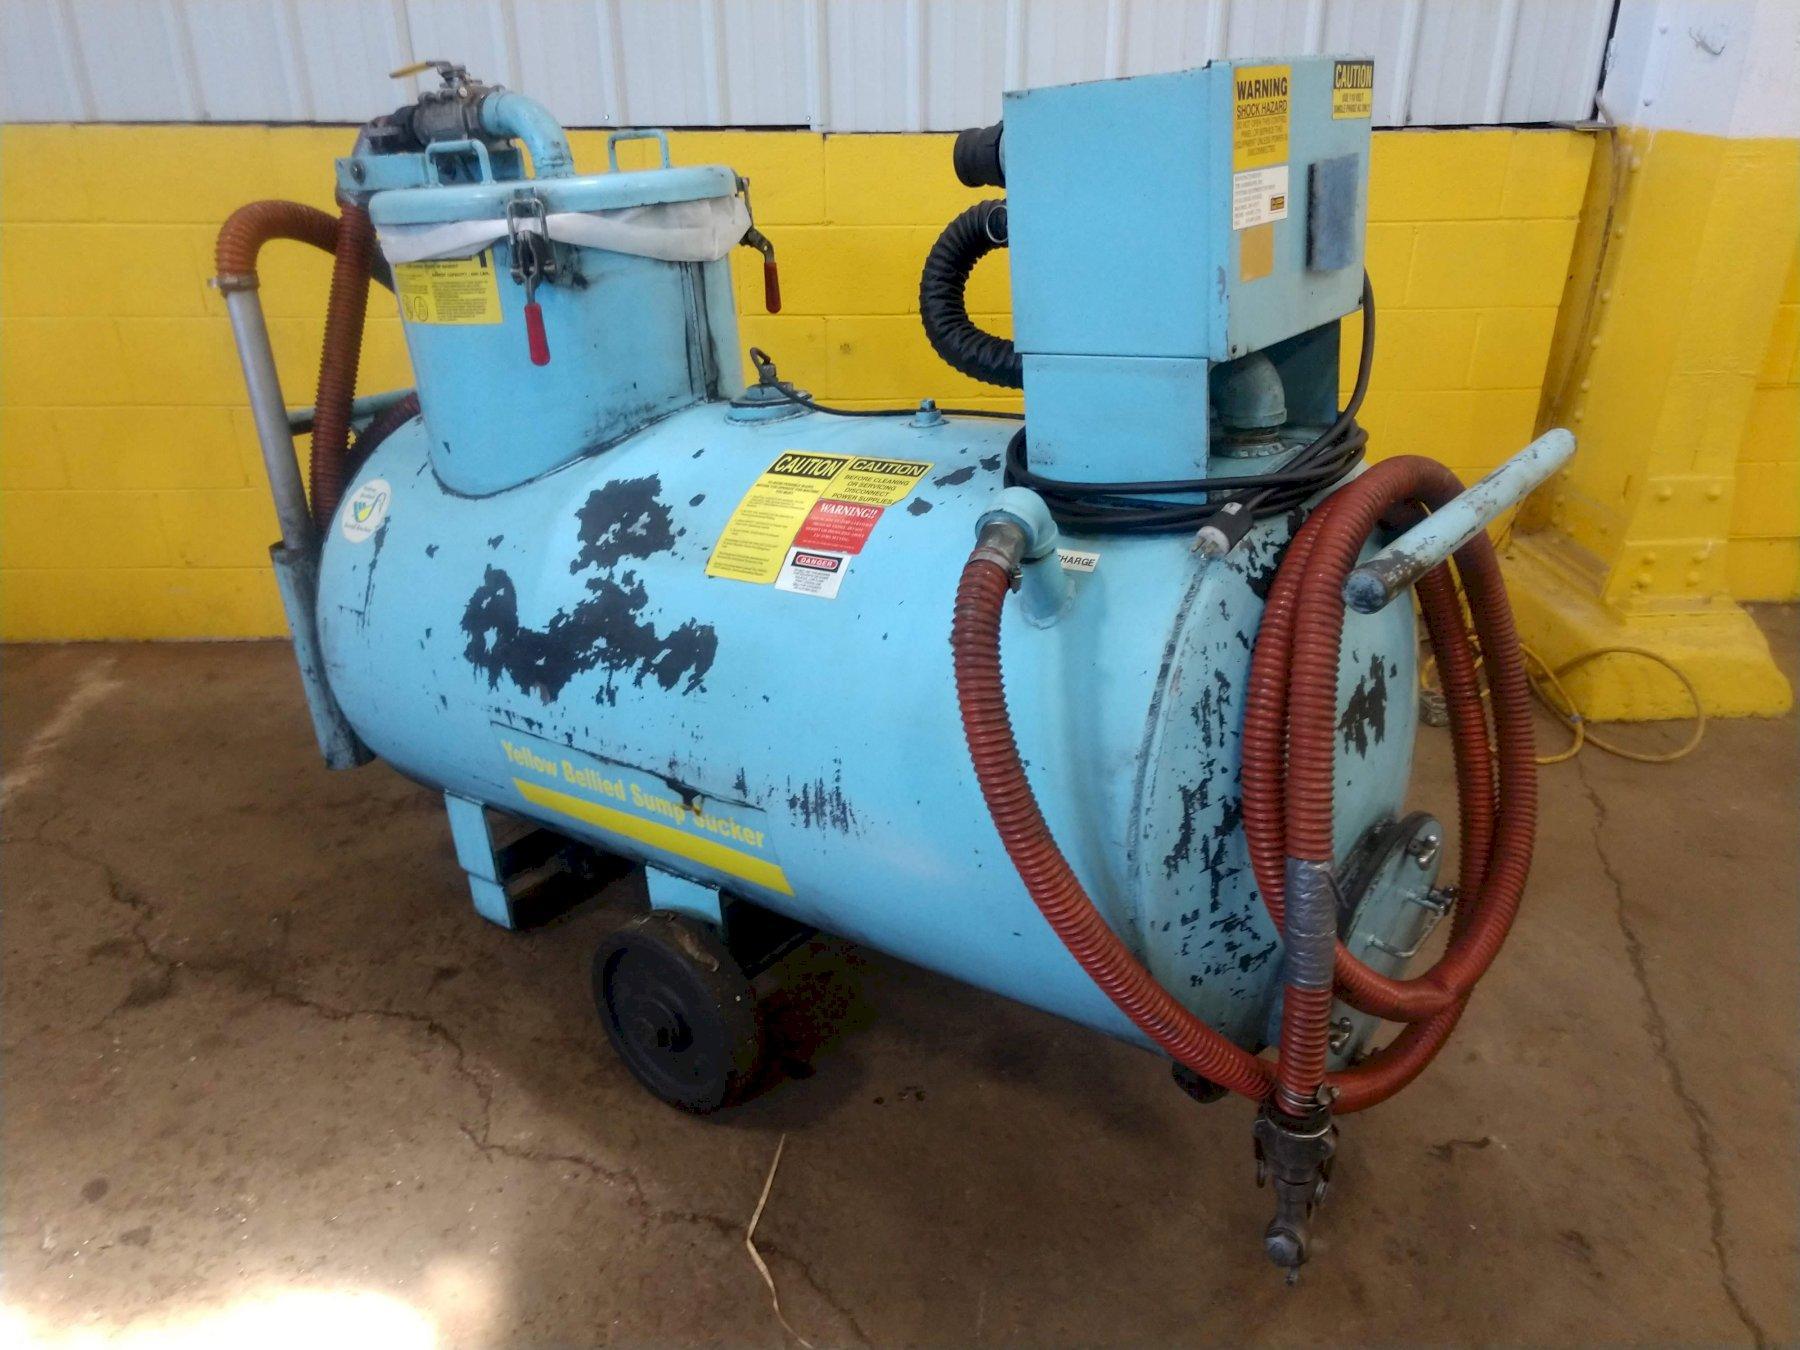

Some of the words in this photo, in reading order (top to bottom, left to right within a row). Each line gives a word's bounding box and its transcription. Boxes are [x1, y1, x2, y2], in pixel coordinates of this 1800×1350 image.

[1335, 64, 1373, 88] CAUTION
[1236, 76, 1288, 101] WARNING
[1236, 102, 1260, 119] SHOCK
[1260, 99, 1288, 115] HAZARD
[774, 455, 843, 477] CAUTION
[852, 460, 925, 476] CAUTION
[844, 474, 872, 482] BEFORE
[873, 477, 910, 486] CLEANING
[859, 482, 897, 491] SERVICING
[832, 493, 858, 501] POWER
[859, 496, 893, 505] SUPPLIES
[844, 487, 890, 497] DISCONNECT
[820, 502, 879, 519] WARNING!!
[801, 556, 833, 567] DANGER
[501, 739, 558, 777] Yellow
[560, 759, 626, 801] Bellied
[630, 783, 686, 825] Sump
